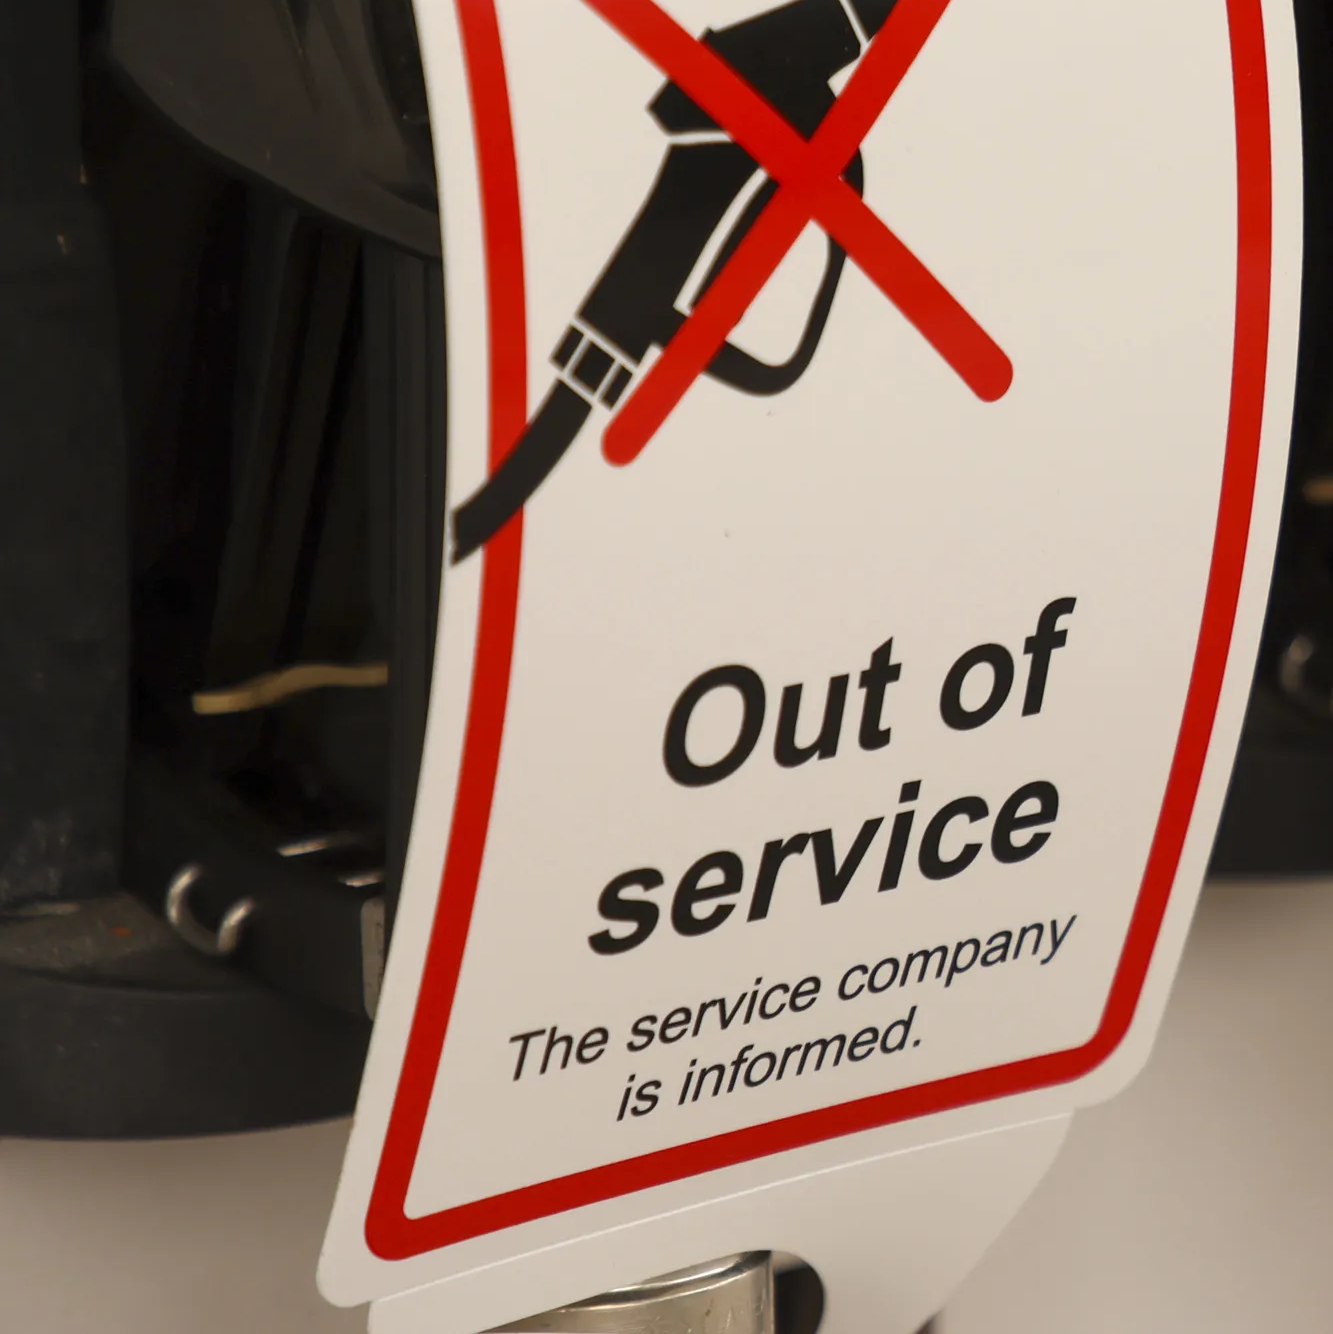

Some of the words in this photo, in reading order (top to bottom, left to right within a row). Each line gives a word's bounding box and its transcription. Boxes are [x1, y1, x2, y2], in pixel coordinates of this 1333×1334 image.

[663, 637, 902, 788] Out
[940, 597, 1077, 731] of
[588, 780, 1059, 955] service
[510, 1026, 608, 1081] The
[627, 976, 821, 1052] service
[838, 915, 1077, 1001] company
[617, 1075, 660, 1121] is
[678, 1006, 920, 1105] informed.
